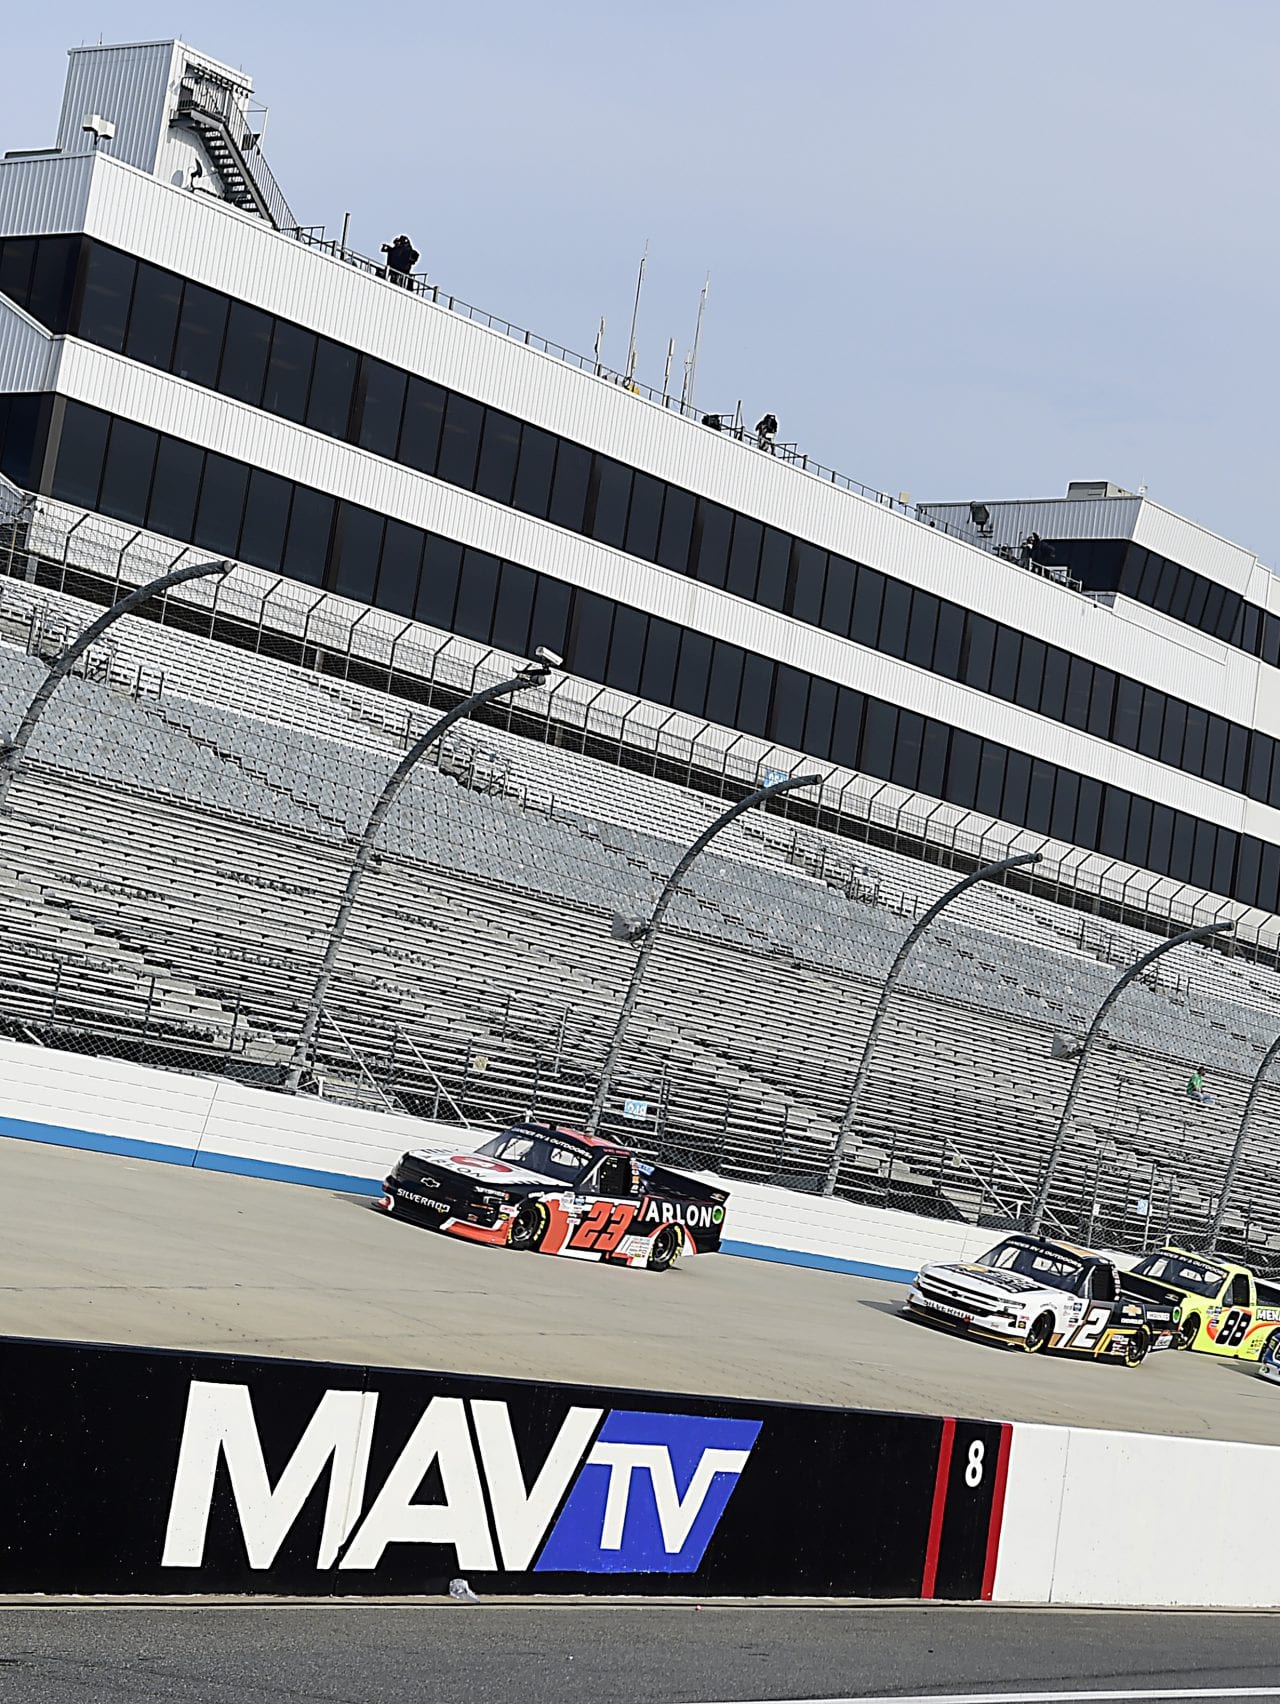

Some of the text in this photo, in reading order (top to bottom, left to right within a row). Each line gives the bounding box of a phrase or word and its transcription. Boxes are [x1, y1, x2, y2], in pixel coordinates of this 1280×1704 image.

[397, 1188, 450, 1213] SILVERADO
[645, 1200, 713, 1228] ARLON
[569, 1200, 636, 1251] 23
[1071, 1307, 1111, 1348] 2
[1215, 1310, 1252, 1347] 88
[964, 1438, 984, 1489] 8
